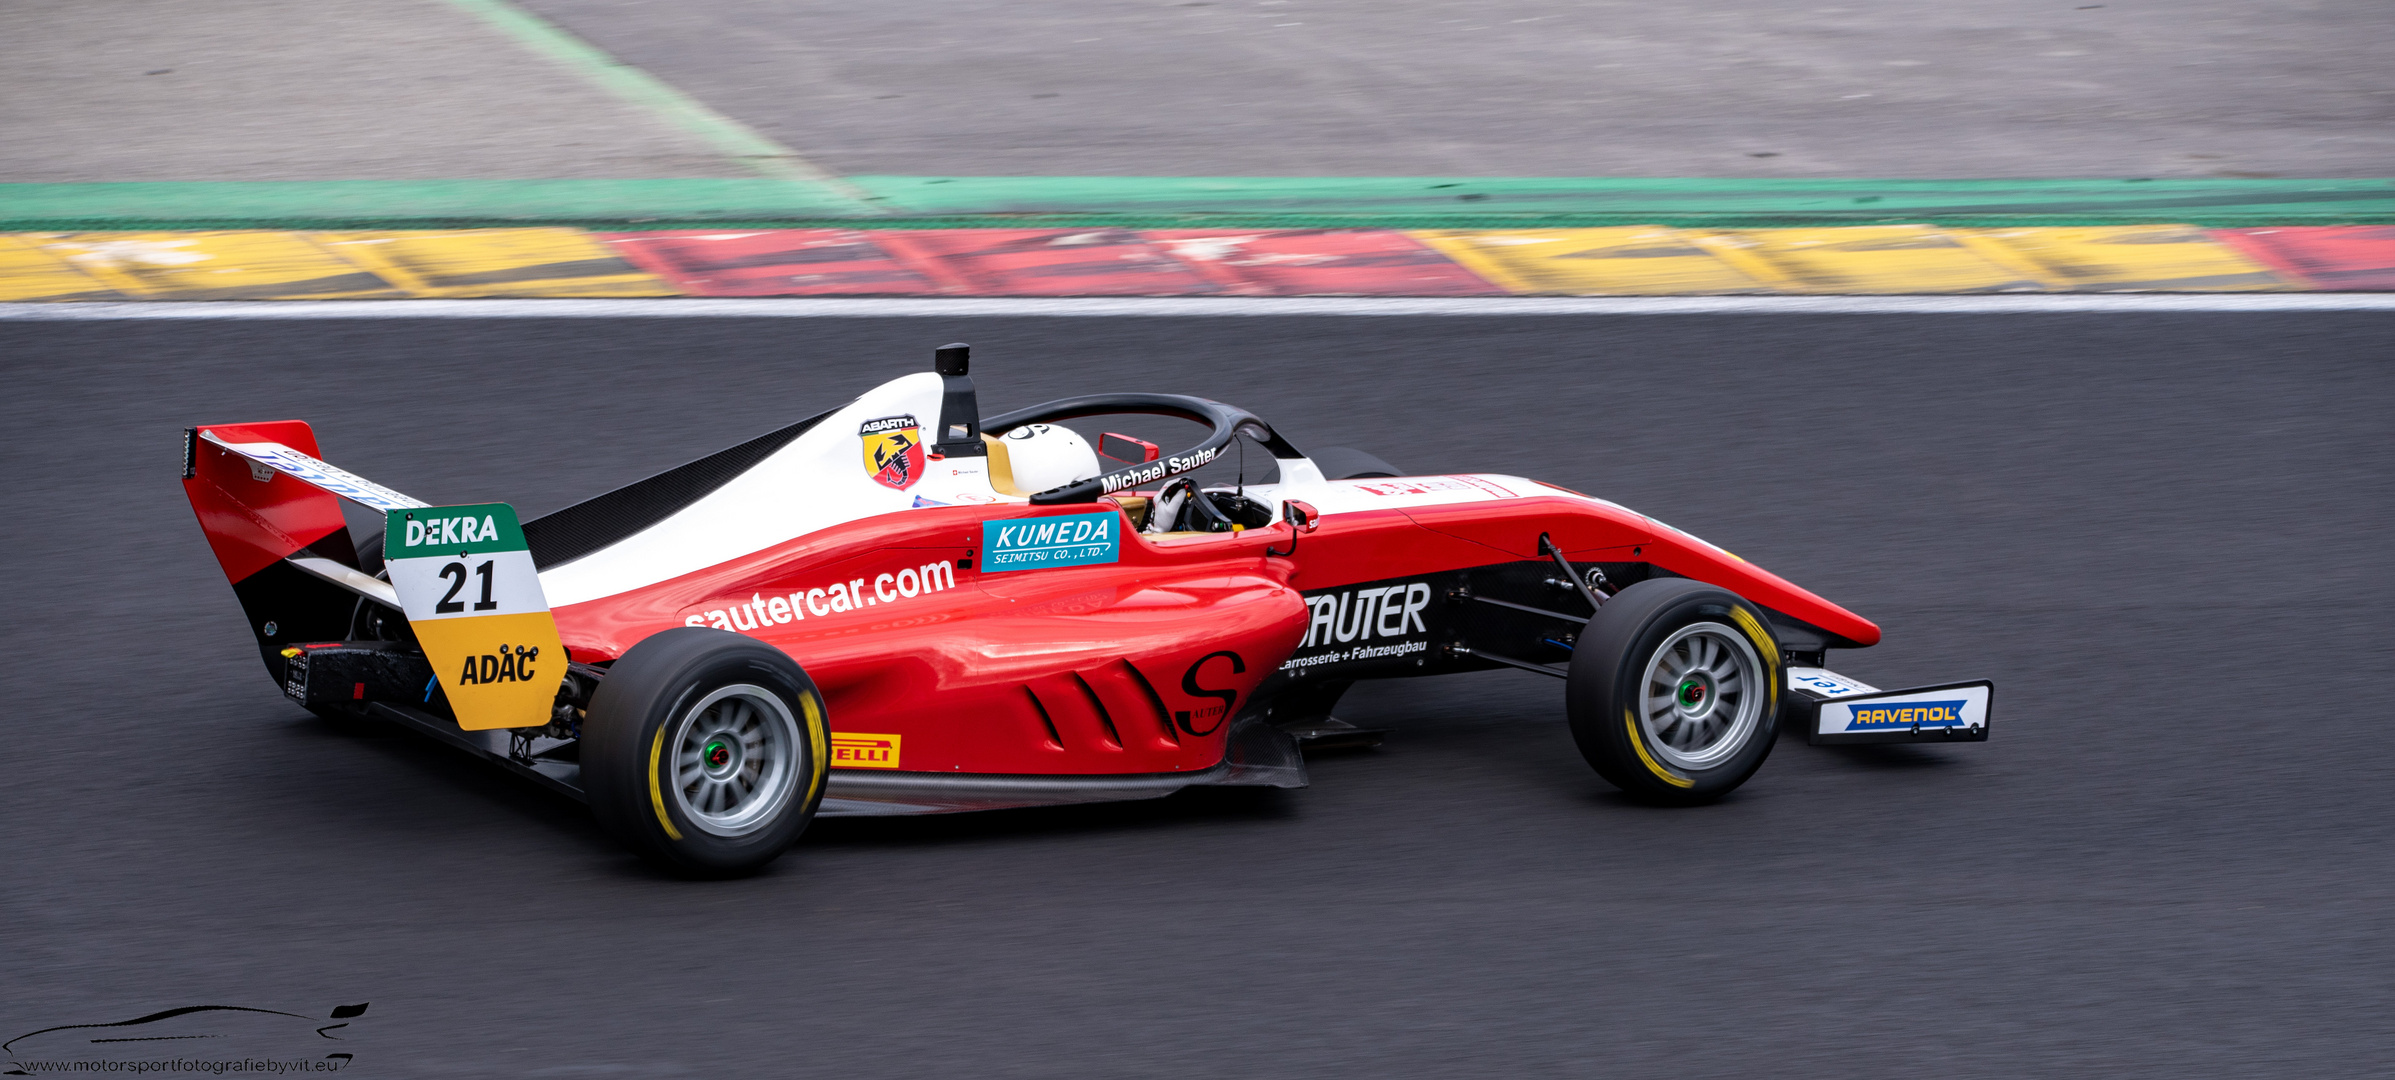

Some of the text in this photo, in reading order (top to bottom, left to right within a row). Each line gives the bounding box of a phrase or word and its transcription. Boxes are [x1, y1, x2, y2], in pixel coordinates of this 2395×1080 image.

[862, 418, 915, 433] ABARTH
[1100, 446, 1217, 494] Michael Sauter
[405, 514, 499, 547] DEKRA
[995, 519, 1108, 548] KUMEDA
[994, 551, 1049, 564] SEIMITSU
[435, 559, 498, 615] 21
[459, 650, 537, 687] ADAC
[1279, 650, 1341, 670] arrosserie
[1351, 641, 1428, 660] Fahrzeugbau
[1856, 706, 1956, 725] RAVENOL
[832, 748, 889, 761] ELLI
